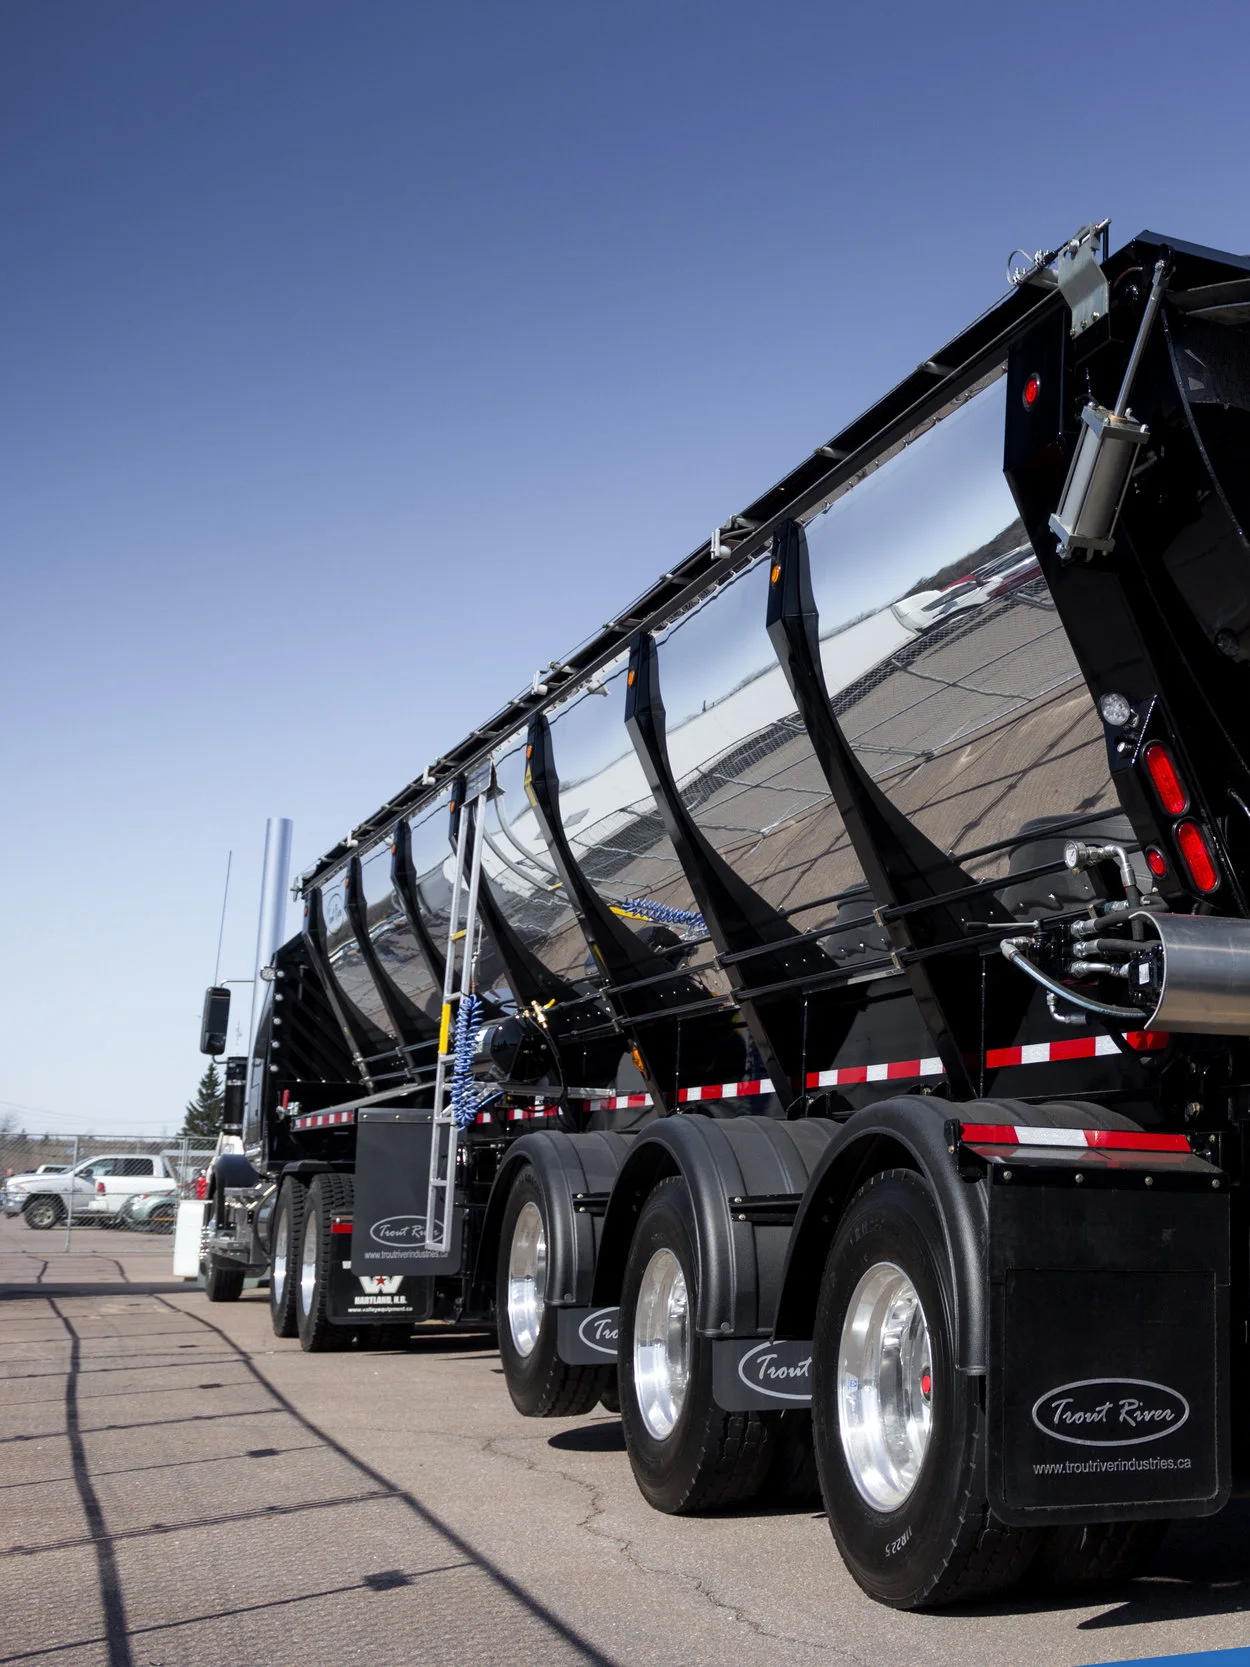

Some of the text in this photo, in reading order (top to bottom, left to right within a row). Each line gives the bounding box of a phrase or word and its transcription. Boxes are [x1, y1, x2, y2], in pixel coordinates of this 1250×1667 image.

[379, 1224, 410, 1237] Trout
[594, 1319, 618, 1339] Tro
[757, 1353, 812, 1380] Trout
[1052, 1398, 1176, 1427] Trout River
[1033, 1456, 1192, 1475] www.troutriverindustries.ca
